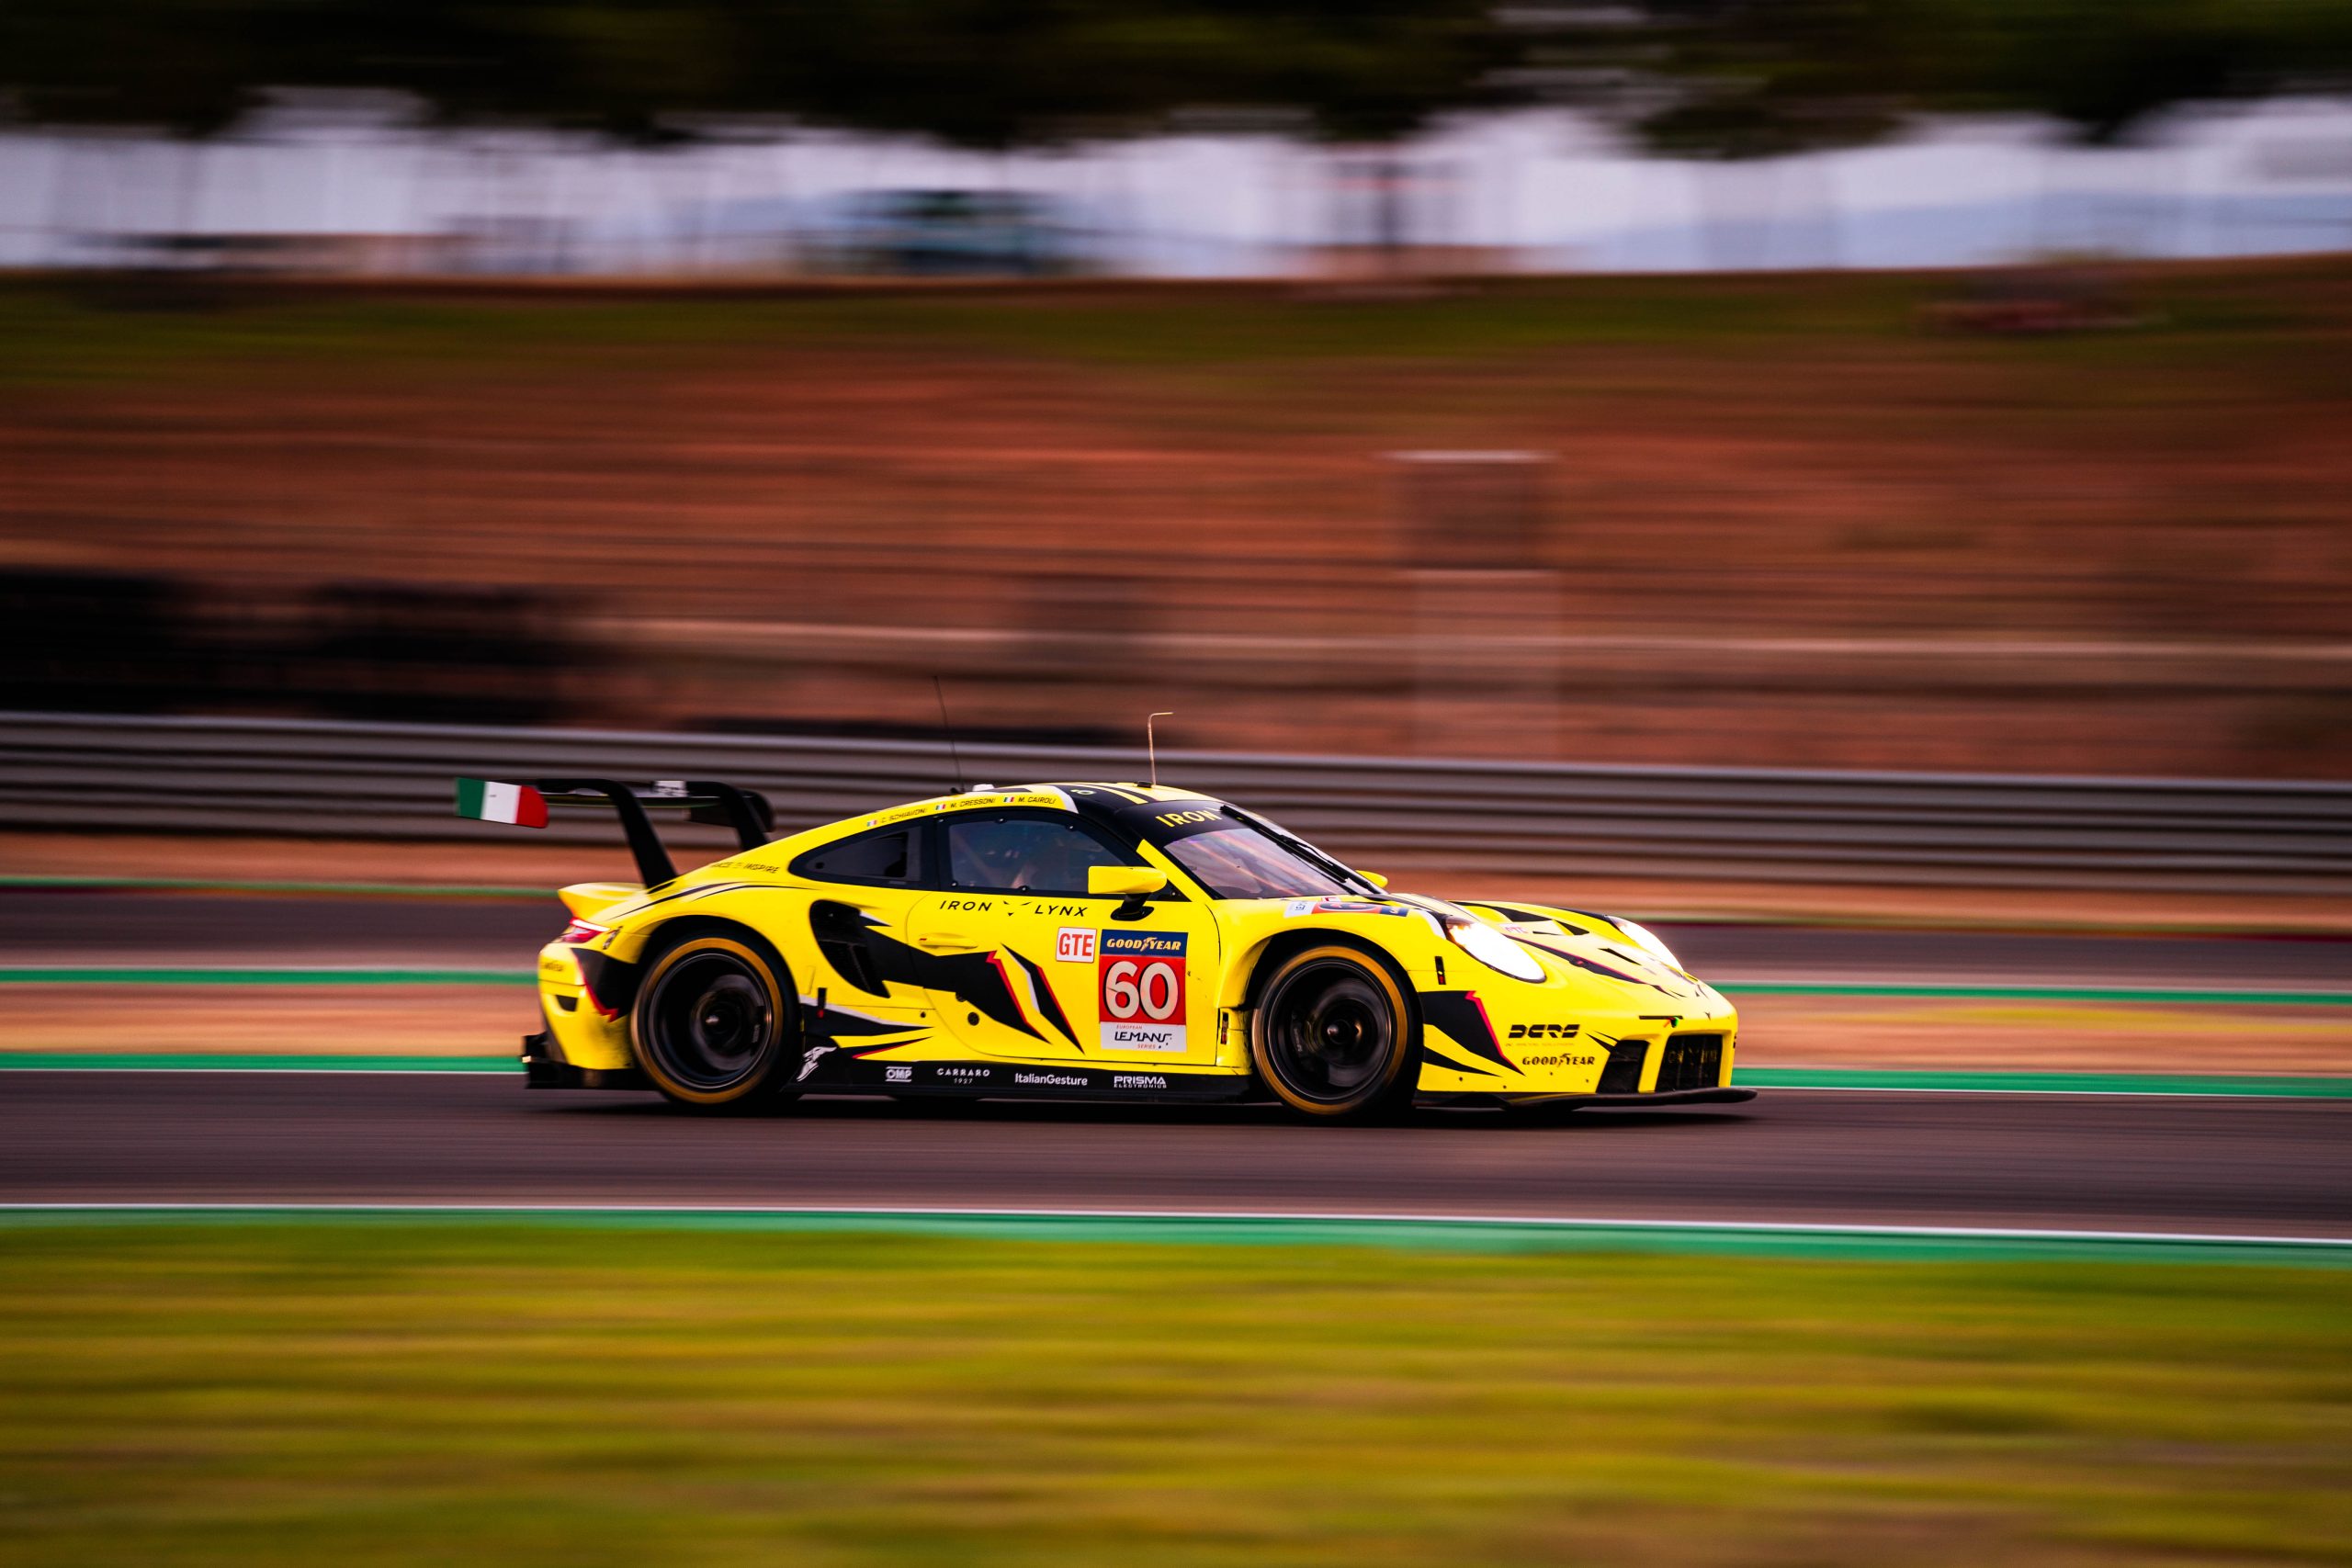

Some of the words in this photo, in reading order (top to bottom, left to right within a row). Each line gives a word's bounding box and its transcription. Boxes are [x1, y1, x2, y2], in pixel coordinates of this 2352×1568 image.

[1155, 809, 1223, 828] IRON
[940, 900, 992, 912] IRON
[1035, 905, 1089, 918] LYNX
[1058, 932, 1094, 957] GTE
[1106, 937, 1182, 952] GOODYEAR
[1103, 961, 1179, 1021] 60
[1521, 1054, 1596, 1067] GOODYEAR
[886, 1067, 912, 1081] OMP
[936, 1067, 991, 1077] CARRARO
[1014, 1072, 1088, 1086] ItalianGesture
[1113, 1076, 1167, 1085] PRISMA
